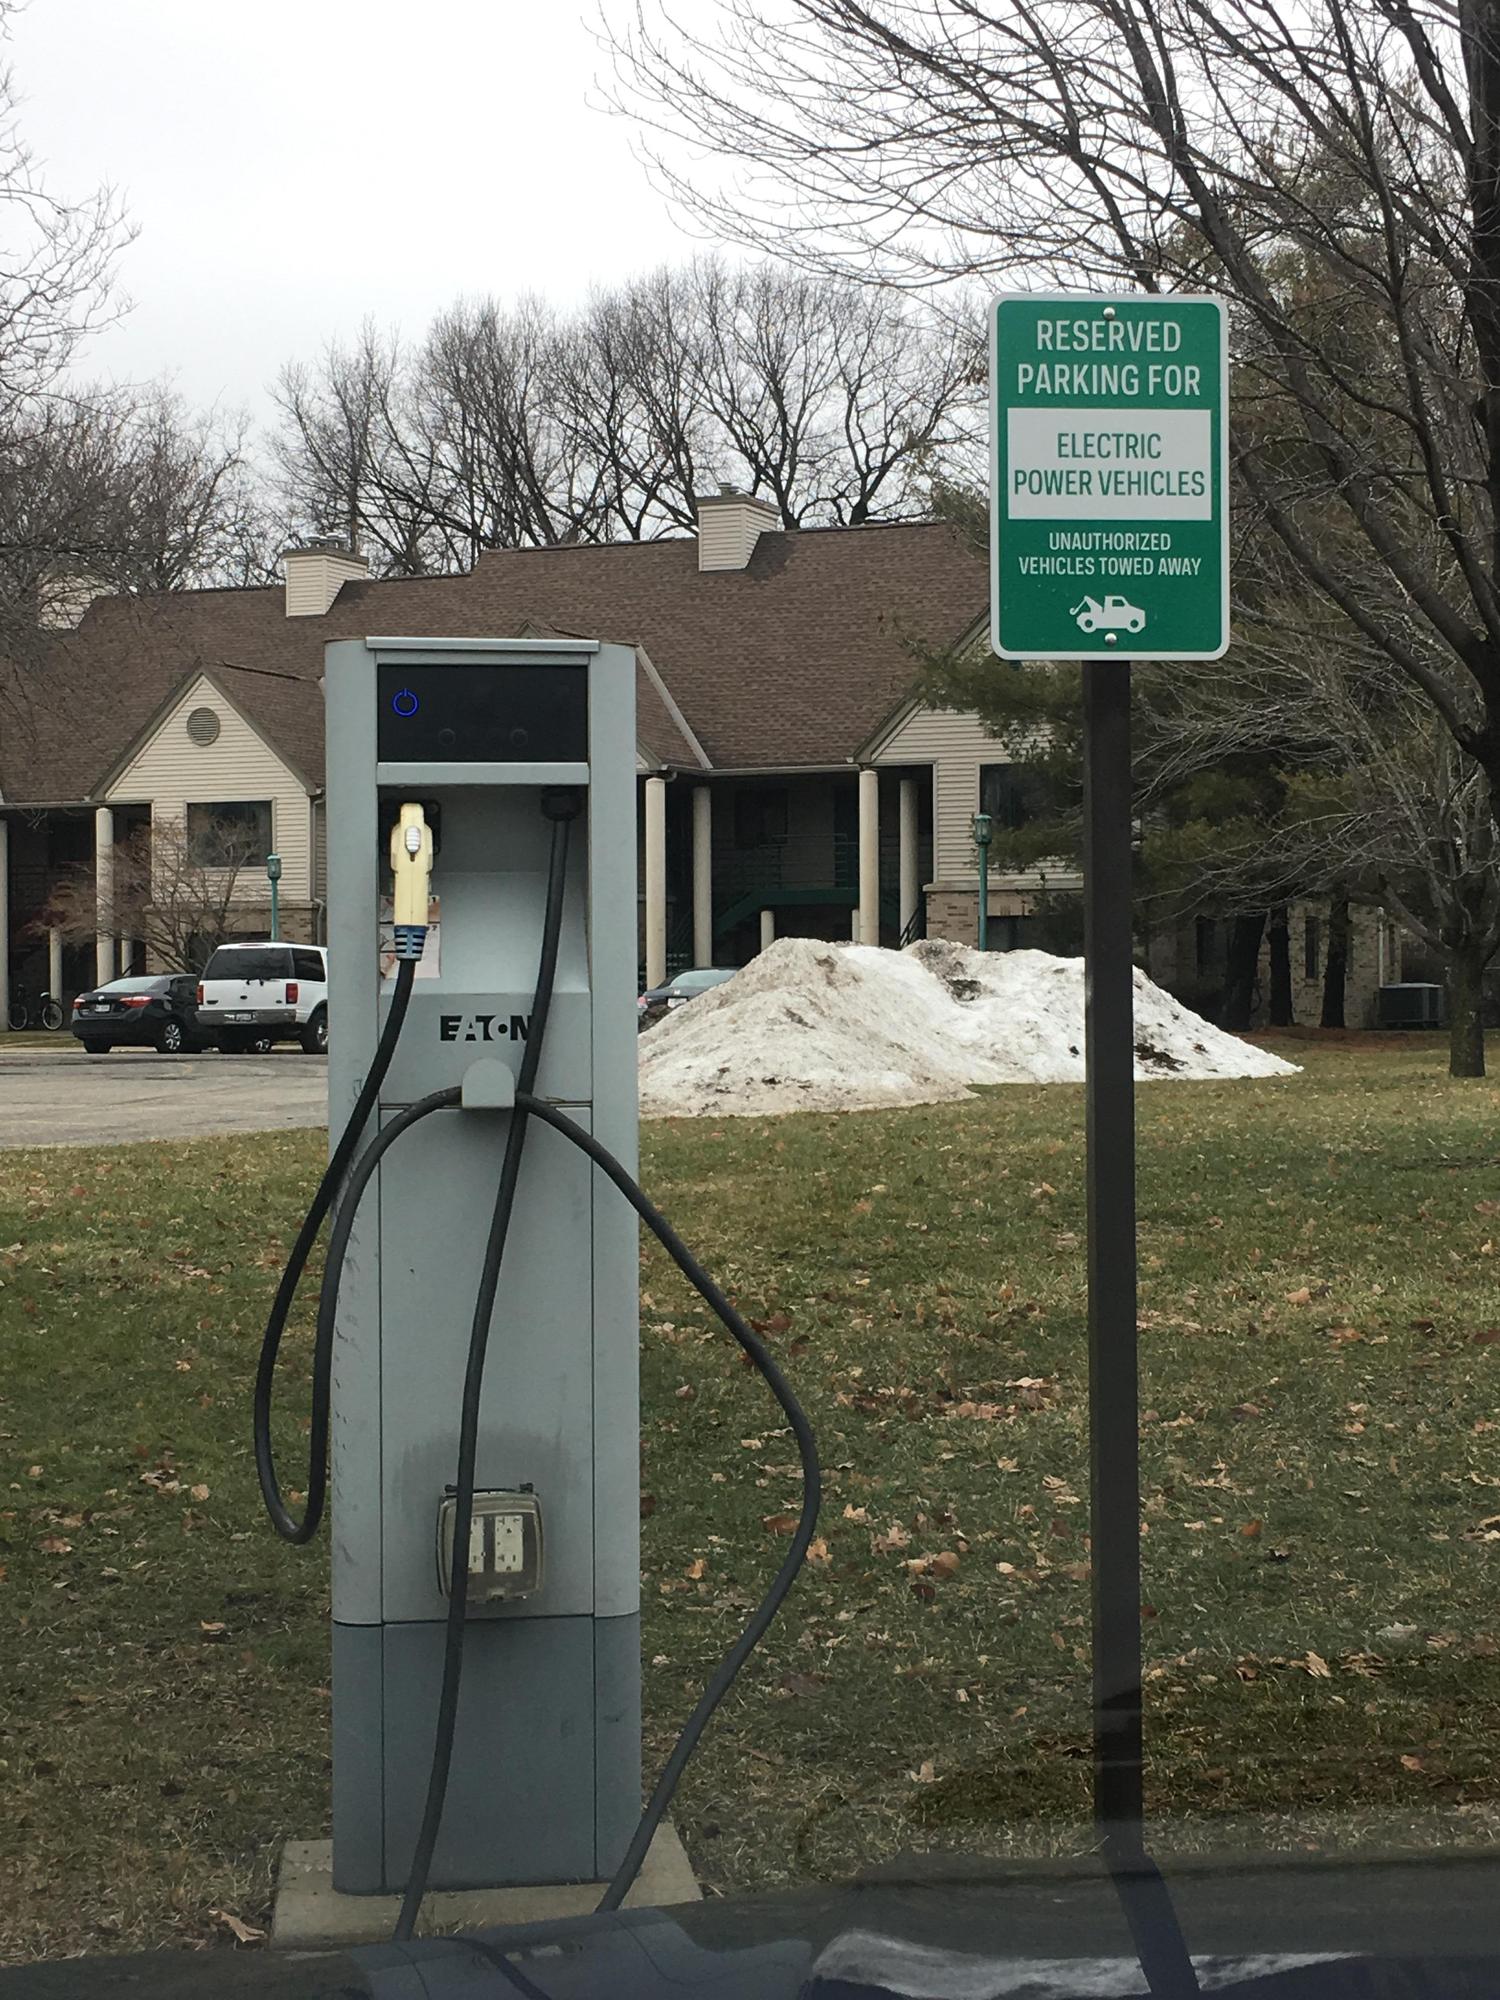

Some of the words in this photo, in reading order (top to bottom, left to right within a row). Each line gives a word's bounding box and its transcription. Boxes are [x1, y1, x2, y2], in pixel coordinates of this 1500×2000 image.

[1037, 319, 1181, 352] RESERVED
[1018, 363, 1139, 396] PARKING
[1148, 364, 1201, 396] FOR
[1057, 432, 1161, 459] ELECTRIC
[1014, 469, 1092, 496] POWER
[1097, 470, 1205, 497] VEHICLES
[1049, 532, 1171, 551] UNAUTHORIZED
[1018, 556, 1095, 575] VEHICLES
[1098, 557, 1154, 576] TOWED
[1158, 557, 1202, 576] AWAY
[440, 1014, 534, 1041] EATON
